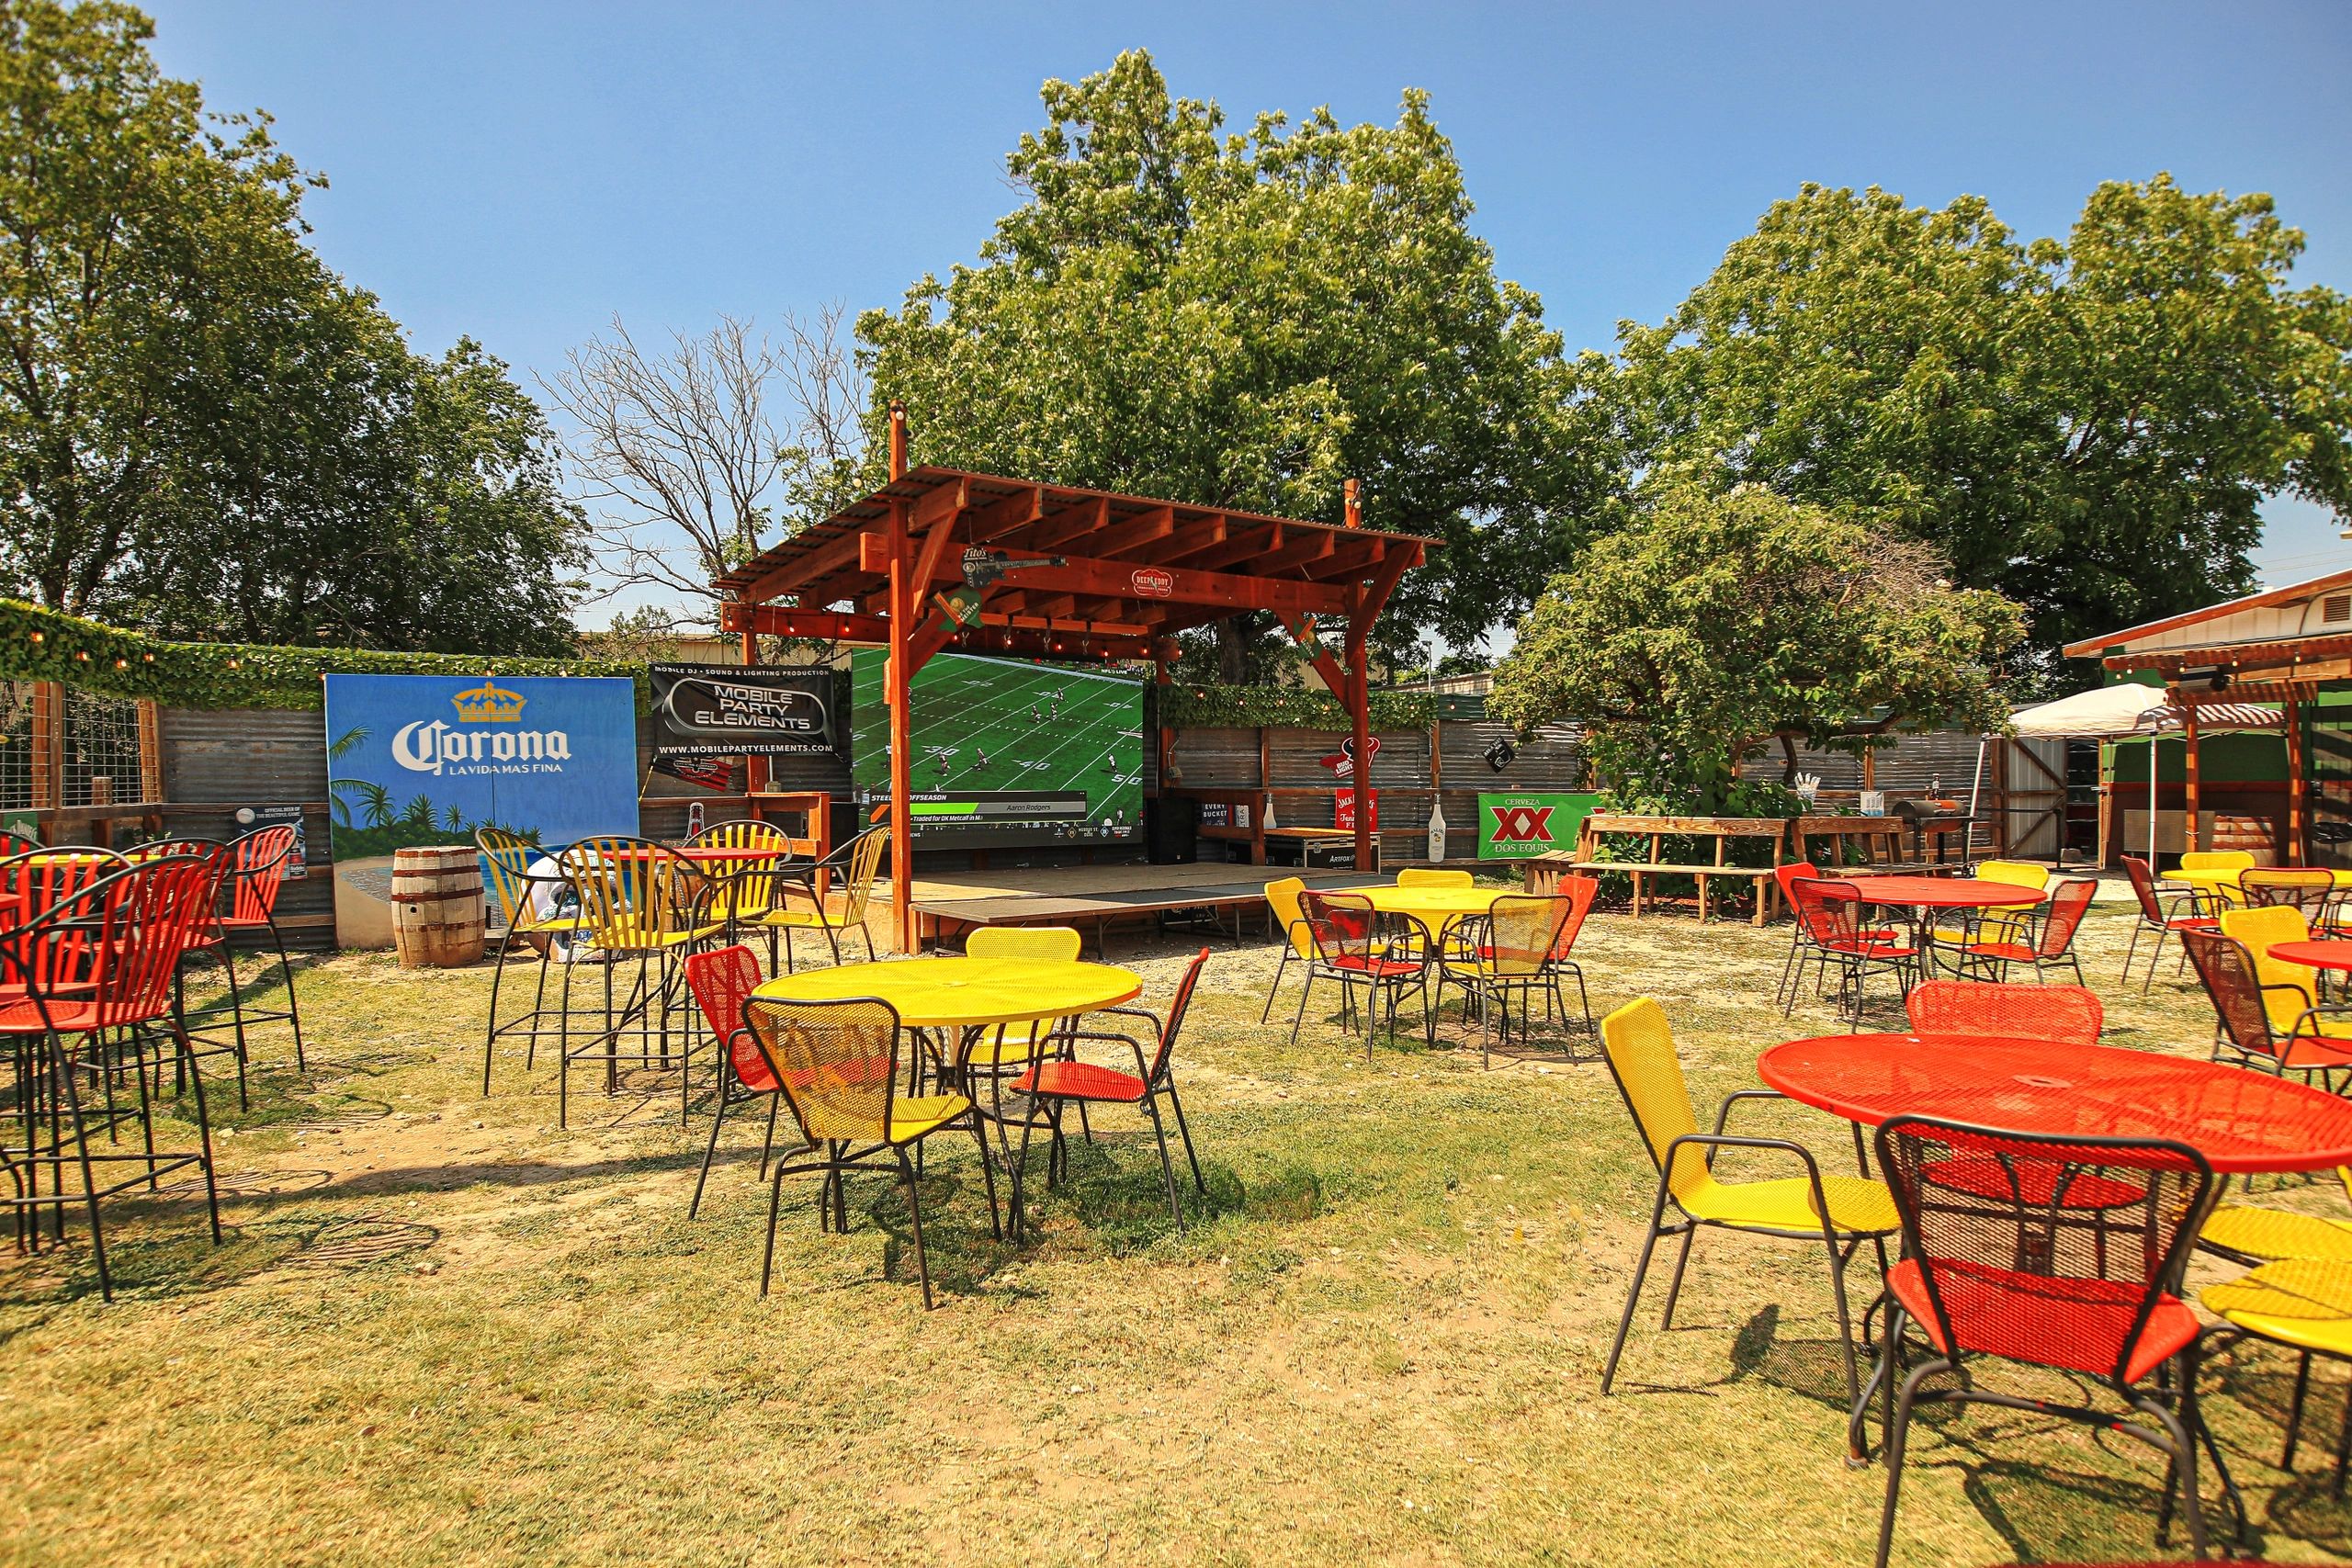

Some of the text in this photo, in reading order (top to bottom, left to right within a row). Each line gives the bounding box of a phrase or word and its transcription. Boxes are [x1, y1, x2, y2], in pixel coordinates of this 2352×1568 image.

[964, 547, 987, 558] Tito's
[1136, 576, 1169, 586] DEEP EDDY
[714, 685, 793, 705] MOBILE
[719, 698, 789, 716] PARTY
[695, 710, 810, 730] ELEMENTS
[391, 719, 572, 776] Corona
[659, 744, 833, 754] WWW.MOBILEPARTYELEMENTS.COM
[449, 763, 563, 775] LA VIDA MAS FINA
[1335, 763, 1353, 774] LIGHT
[1336, 760, 1350, 770] BUD
[1338, 795, 1352, 809] JACK
[1488, 806, 1556, 842] XX
[1495, 843, 1551, 853] DOS EQUIS
